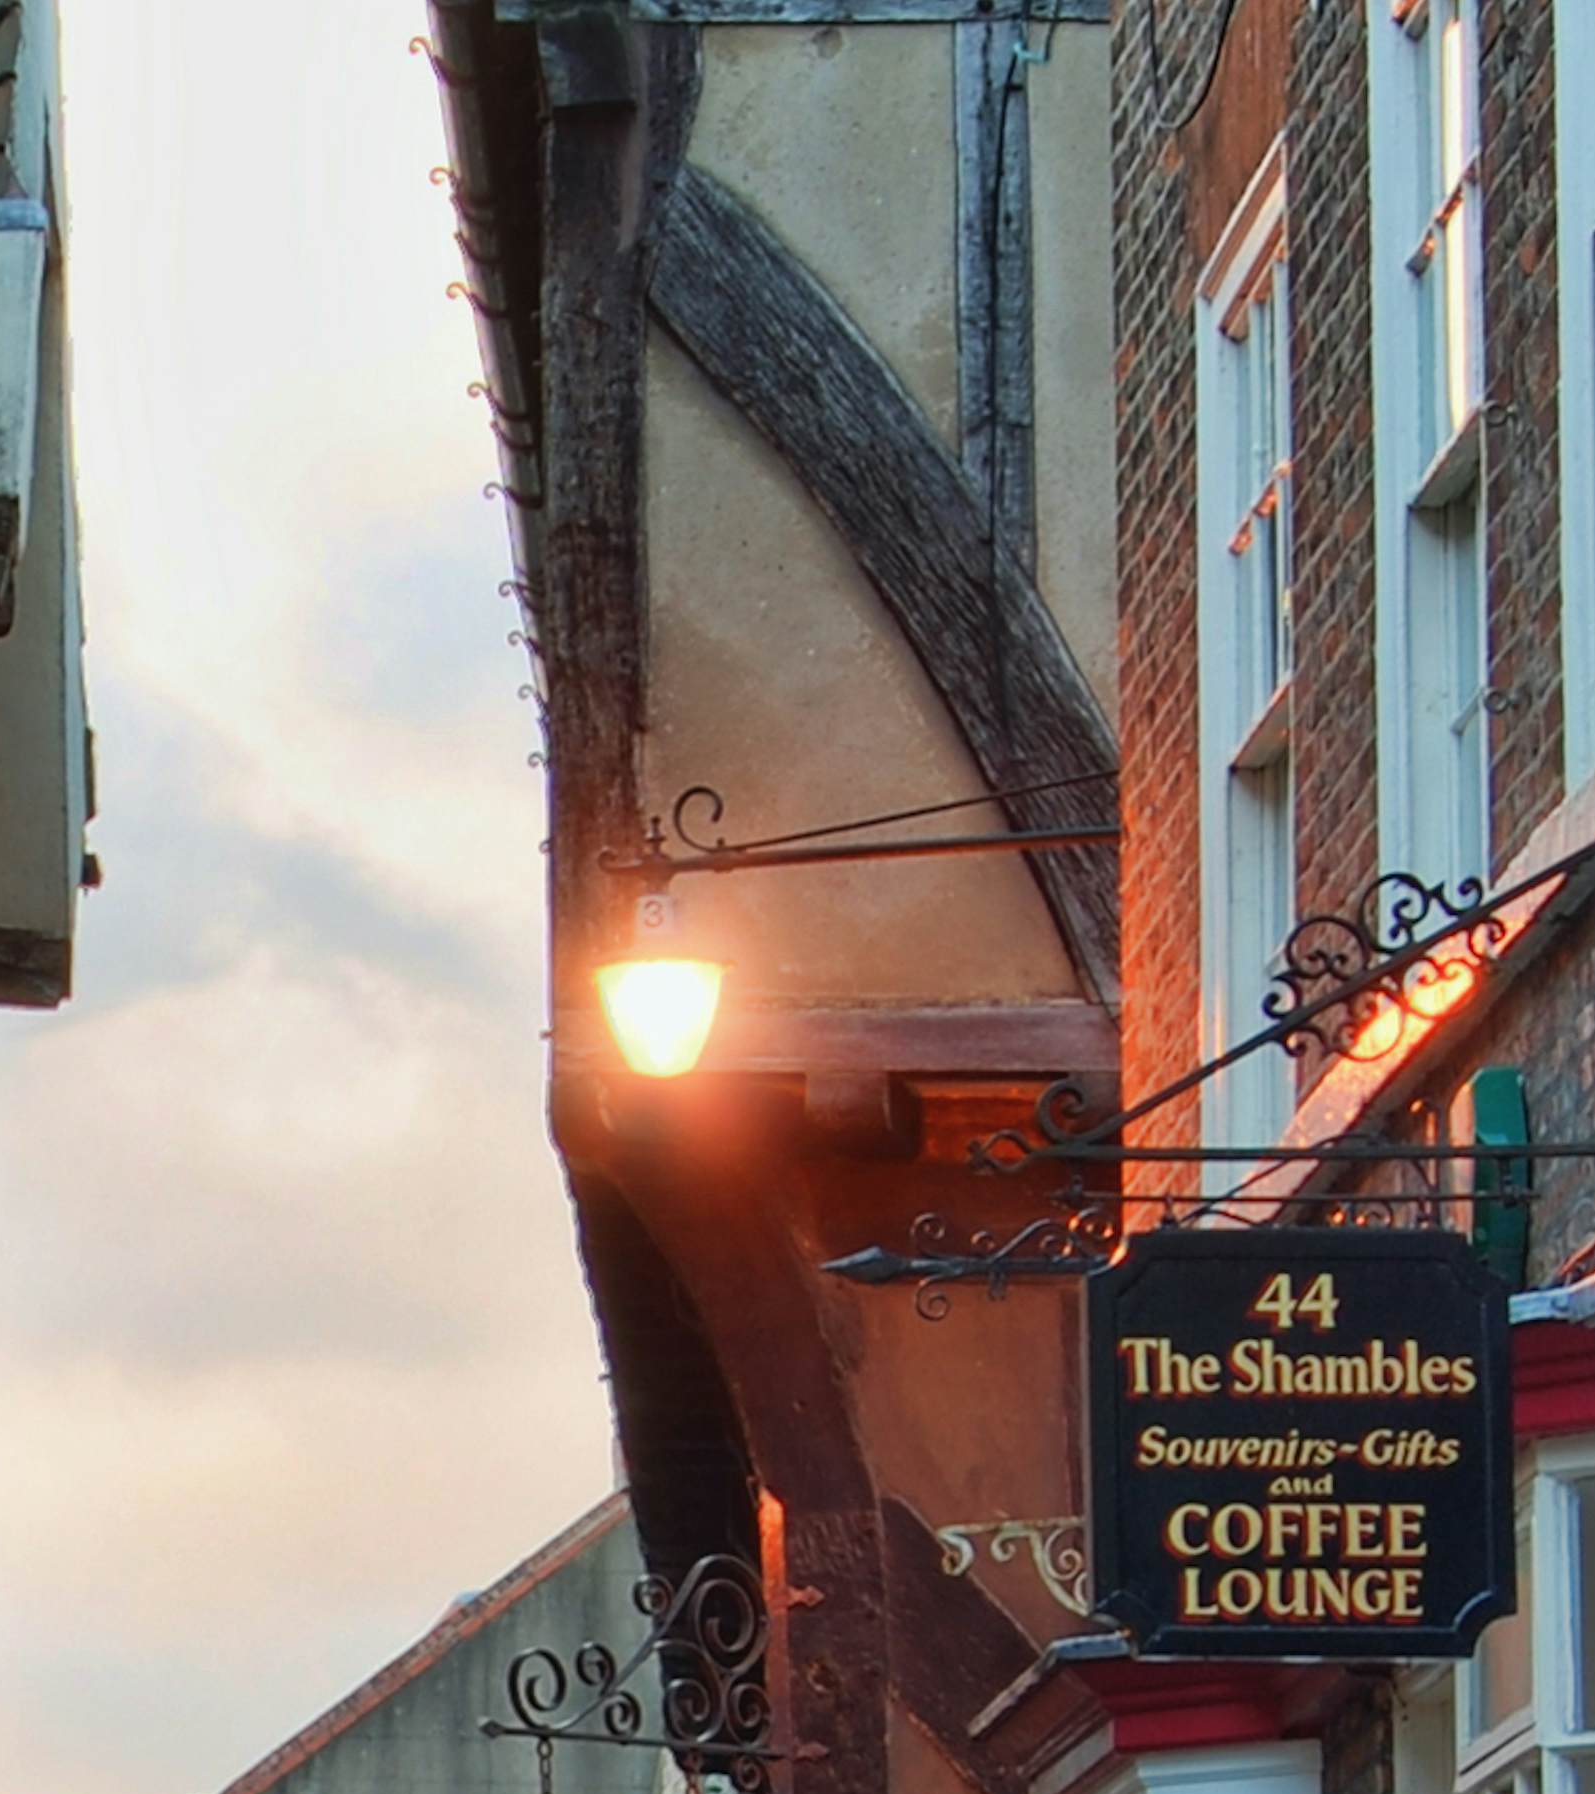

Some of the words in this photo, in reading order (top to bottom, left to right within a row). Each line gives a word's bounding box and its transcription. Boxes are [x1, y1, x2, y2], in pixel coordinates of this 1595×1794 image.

[644, 899, 664, 929] 3
[1250, 1272, 1340, 1331] 44
[1119, 1337, 1222, 1395] The
[1230, 1338, 1478, 1395] Shambles
[1268, 1473, 1334, 1496] and
[1167, 1503, 1427, 1558] COFFEE
[1182, 1567, 1424, 1618] LOUNGE
